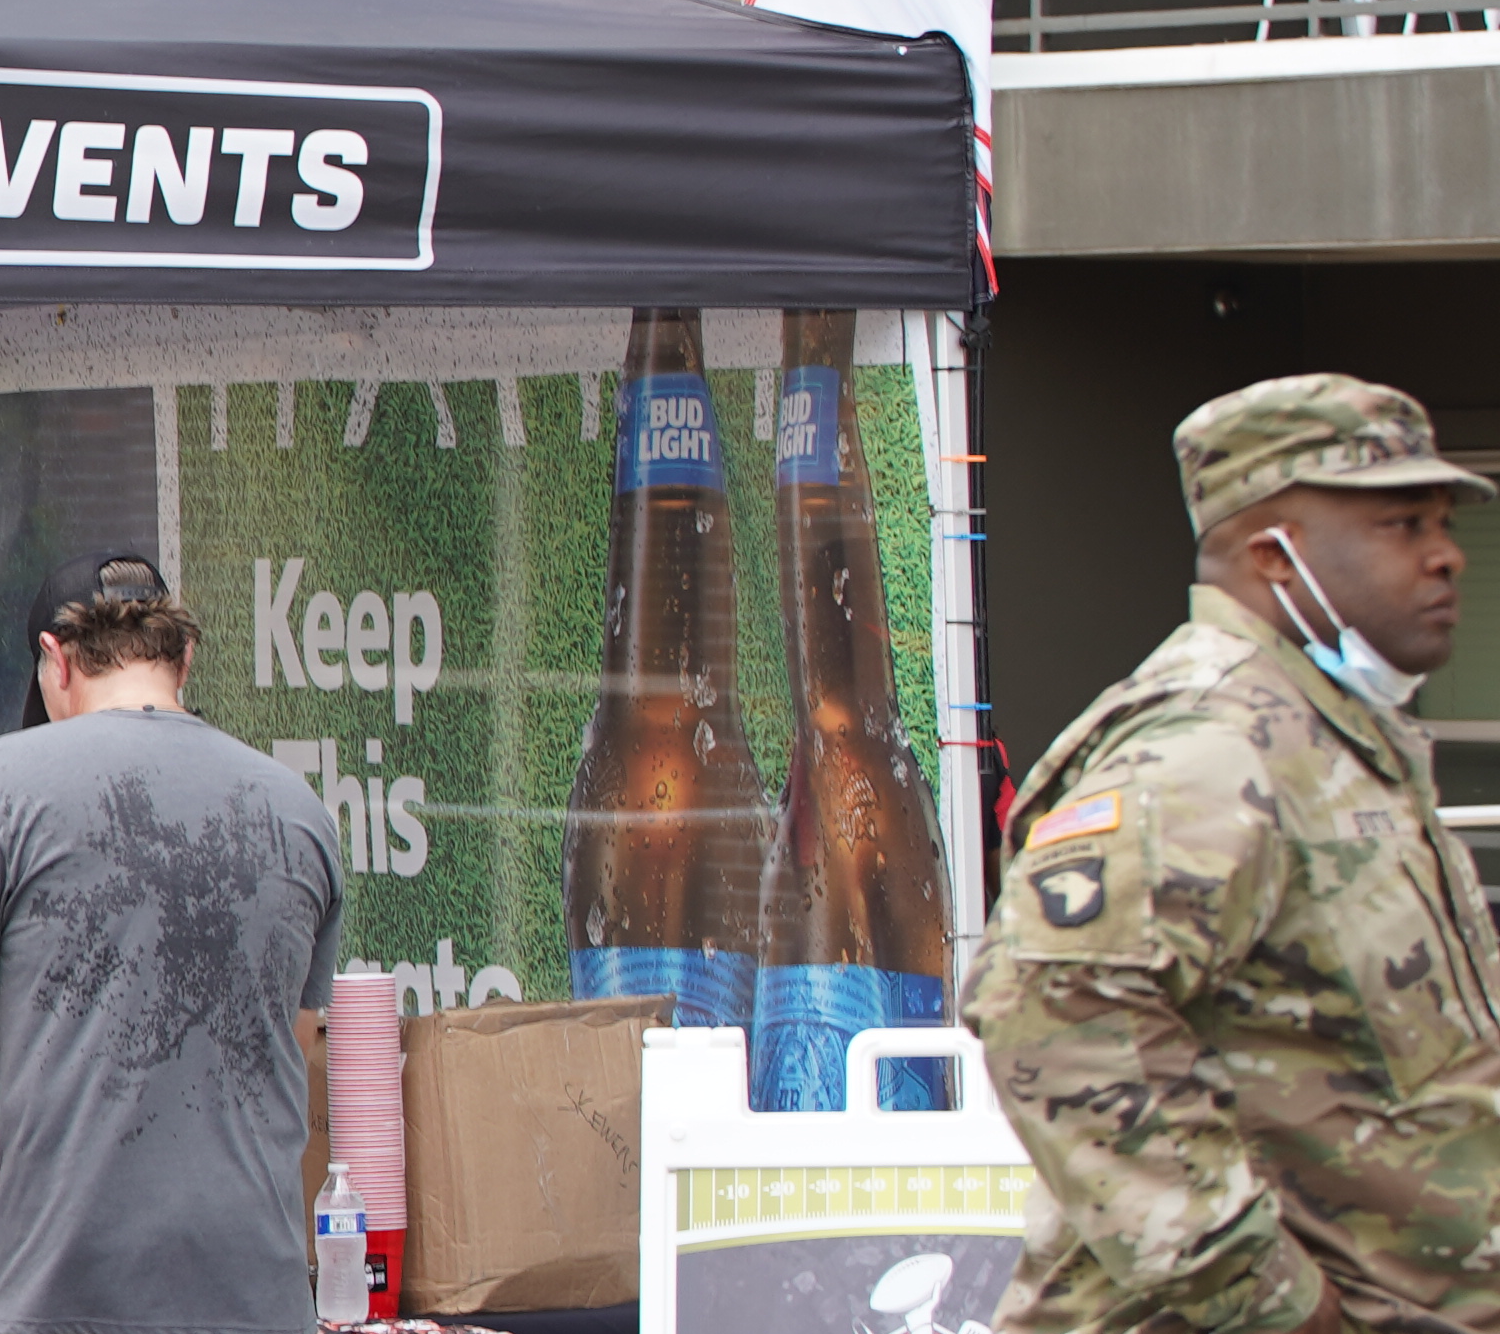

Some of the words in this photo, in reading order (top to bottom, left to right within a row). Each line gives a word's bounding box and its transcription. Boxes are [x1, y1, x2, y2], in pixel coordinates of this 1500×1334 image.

[650, 397, 704, 429] BUD
[638, 427, 711, 463] LIGHT
[253, 556, 444, 726] Keep
